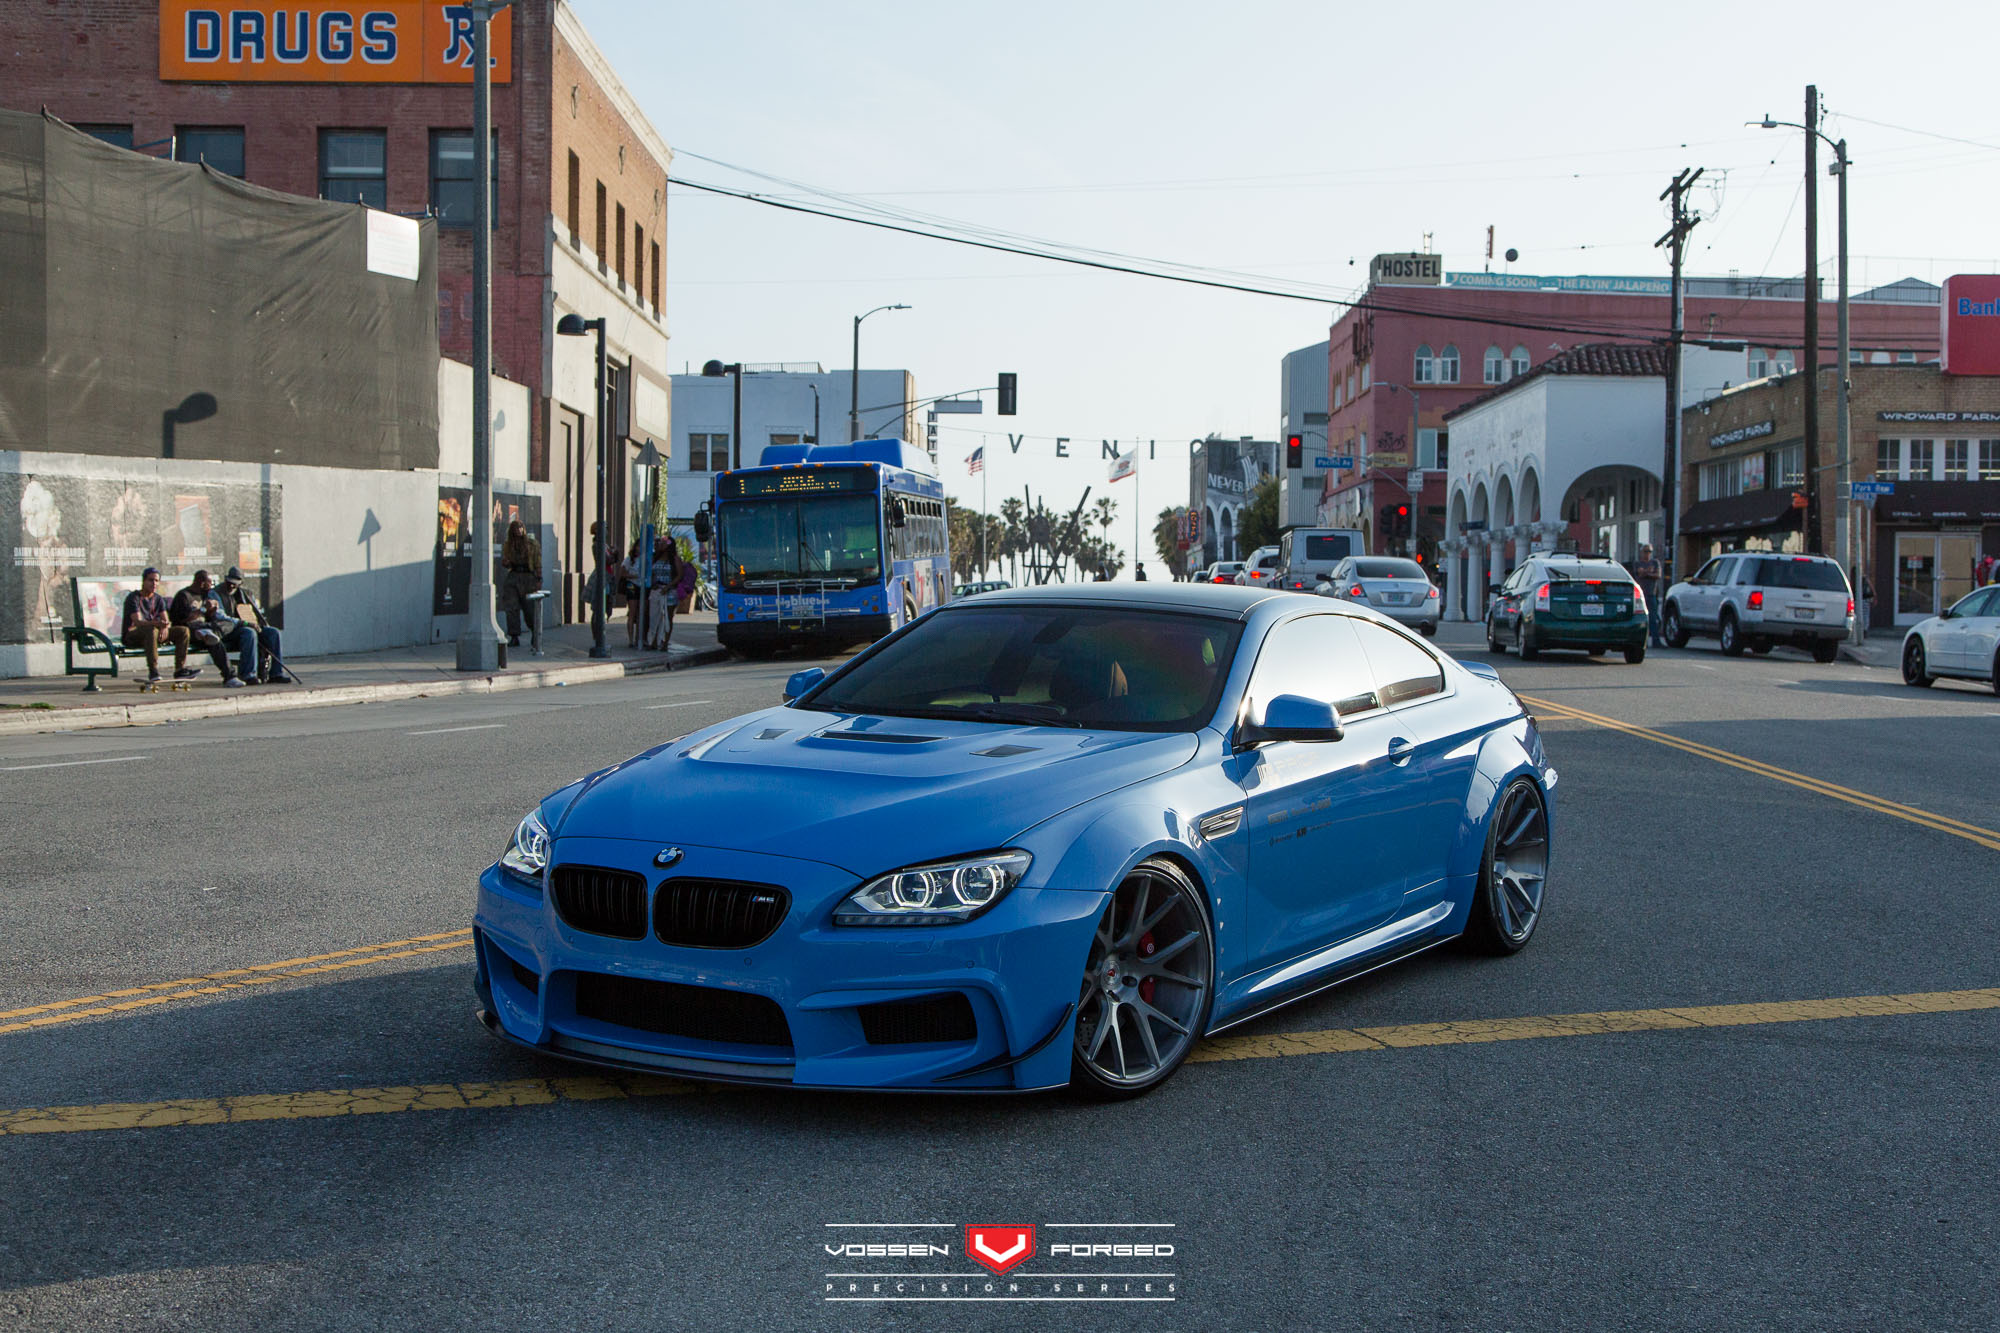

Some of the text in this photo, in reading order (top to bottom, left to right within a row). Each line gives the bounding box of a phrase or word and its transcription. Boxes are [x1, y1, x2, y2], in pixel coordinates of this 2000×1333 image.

[184, 10, 398, 64] DRUGS
[1383, 259, 1440, 277] HOSTEL
[1459, 274, 1504, 286] COMING
[1507, 276, 1537, 288] SOON
[1557, 278, 1578, 288] THE
[1882, 412, 1957, 421] WINDWARD
[1317, 458, 1340, 467] Pacific
[1208, 472, 1244, 493] NEVER
[1854, 484, 1871, 493] Park
[744, 597, 763, 606] 1311
